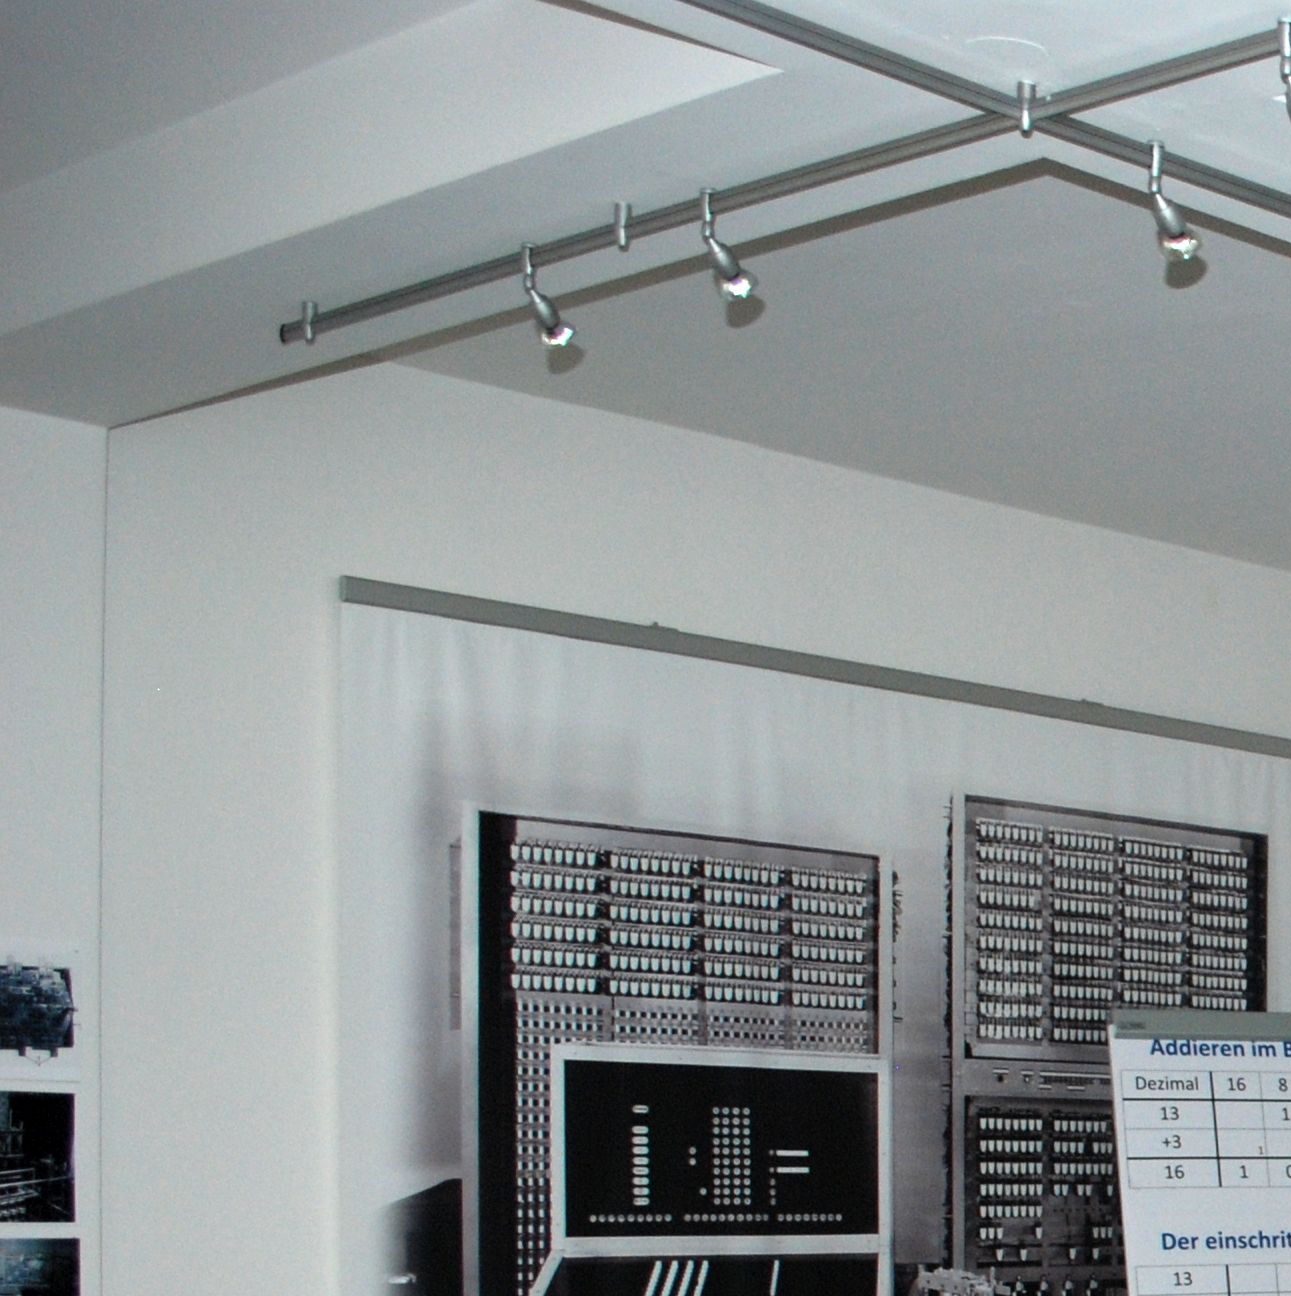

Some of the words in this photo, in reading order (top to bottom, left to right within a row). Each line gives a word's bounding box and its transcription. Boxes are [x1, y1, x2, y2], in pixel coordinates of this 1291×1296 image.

[1150, 1039, 1245, 1058] Addieren
[1252, 1041, 1277, 1058] im
[1135, 1076, 1199, 1091] Dezimal
[1227, 1078, 1246, 1092] 16
[1278, 1078, 1288, 1092] 8
[1160, 1107, 1179, 1121] 13
[1282, 1109, 1290, 1122] 1
[1161, 1135, 1182, 1149] +3
[1165, 1165, 1185, 1180] 16
[1240, 1165, 1248, 1179] 1
[1161, 1232, 1199, 1251] Der
[1174, 1272, 1193, 1287] 13
